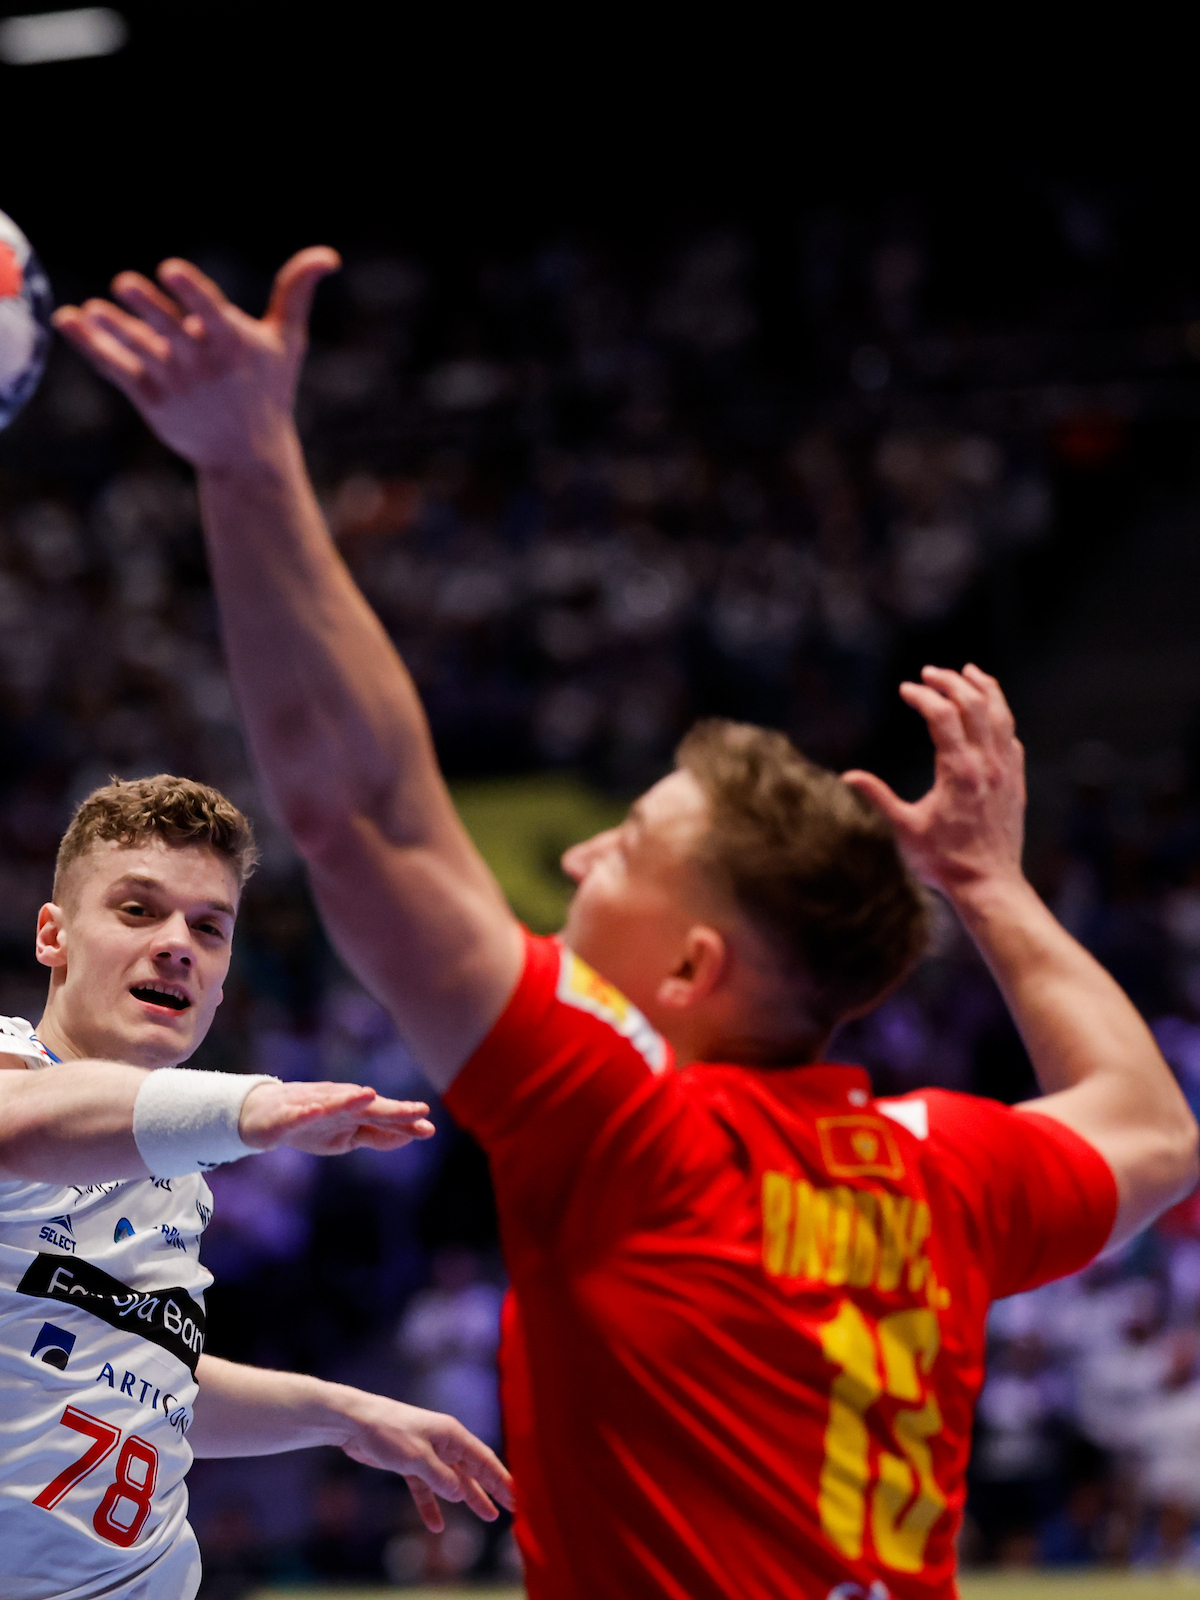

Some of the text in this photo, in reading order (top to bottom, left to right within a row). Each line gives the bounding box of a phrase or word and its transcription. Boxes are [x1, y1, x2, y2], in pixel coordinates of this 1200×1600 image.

[38, 1226, 77, 1254] SELECT
[31, 1404, 159, 1548] 78
[817, 1300, 945, 1572] 13
